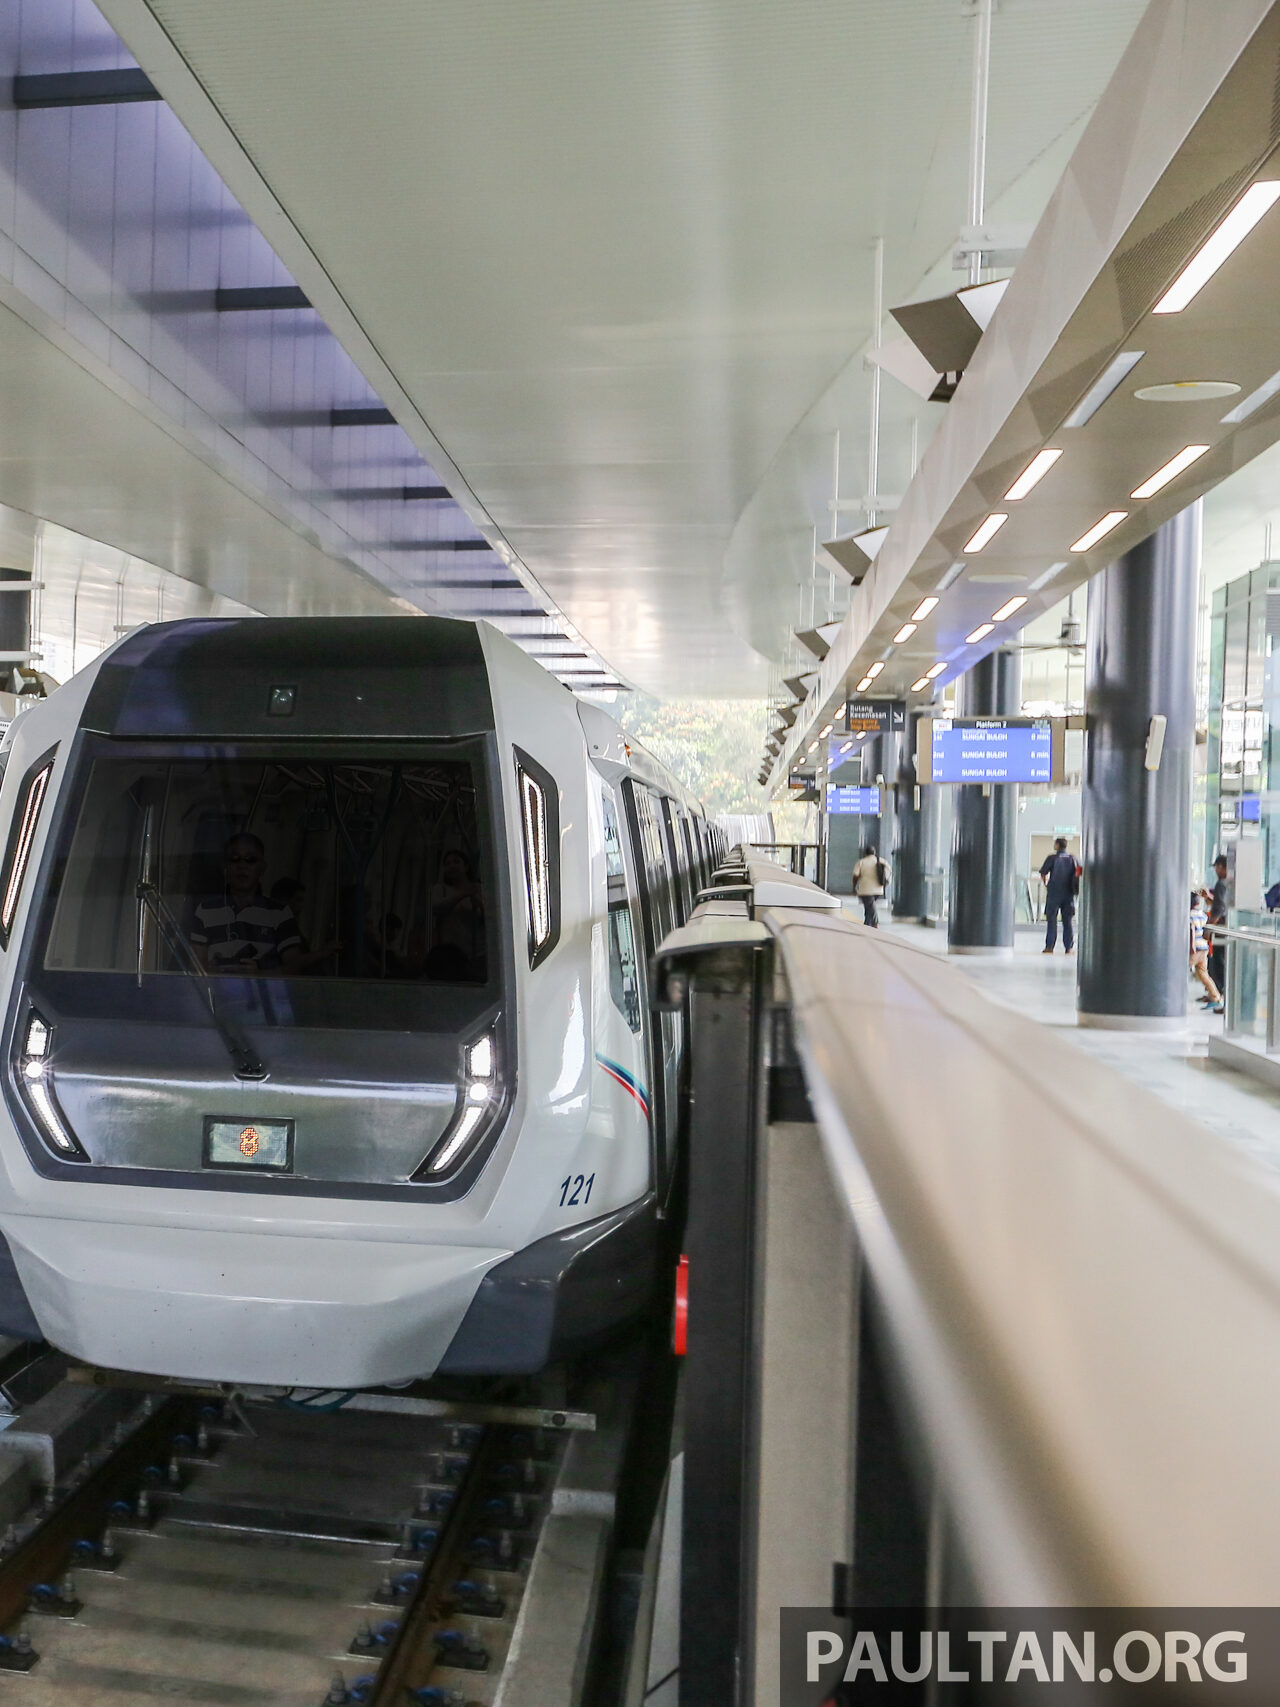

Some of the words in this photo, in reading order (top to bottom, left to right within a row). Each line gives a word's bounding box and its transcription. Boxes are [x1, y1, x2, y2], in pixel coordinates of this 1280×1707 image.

[975, 720, 1002, 729] Platform
[239, 1127, 259, 1158] 8
[559, 1172, 596, 1207] 121
